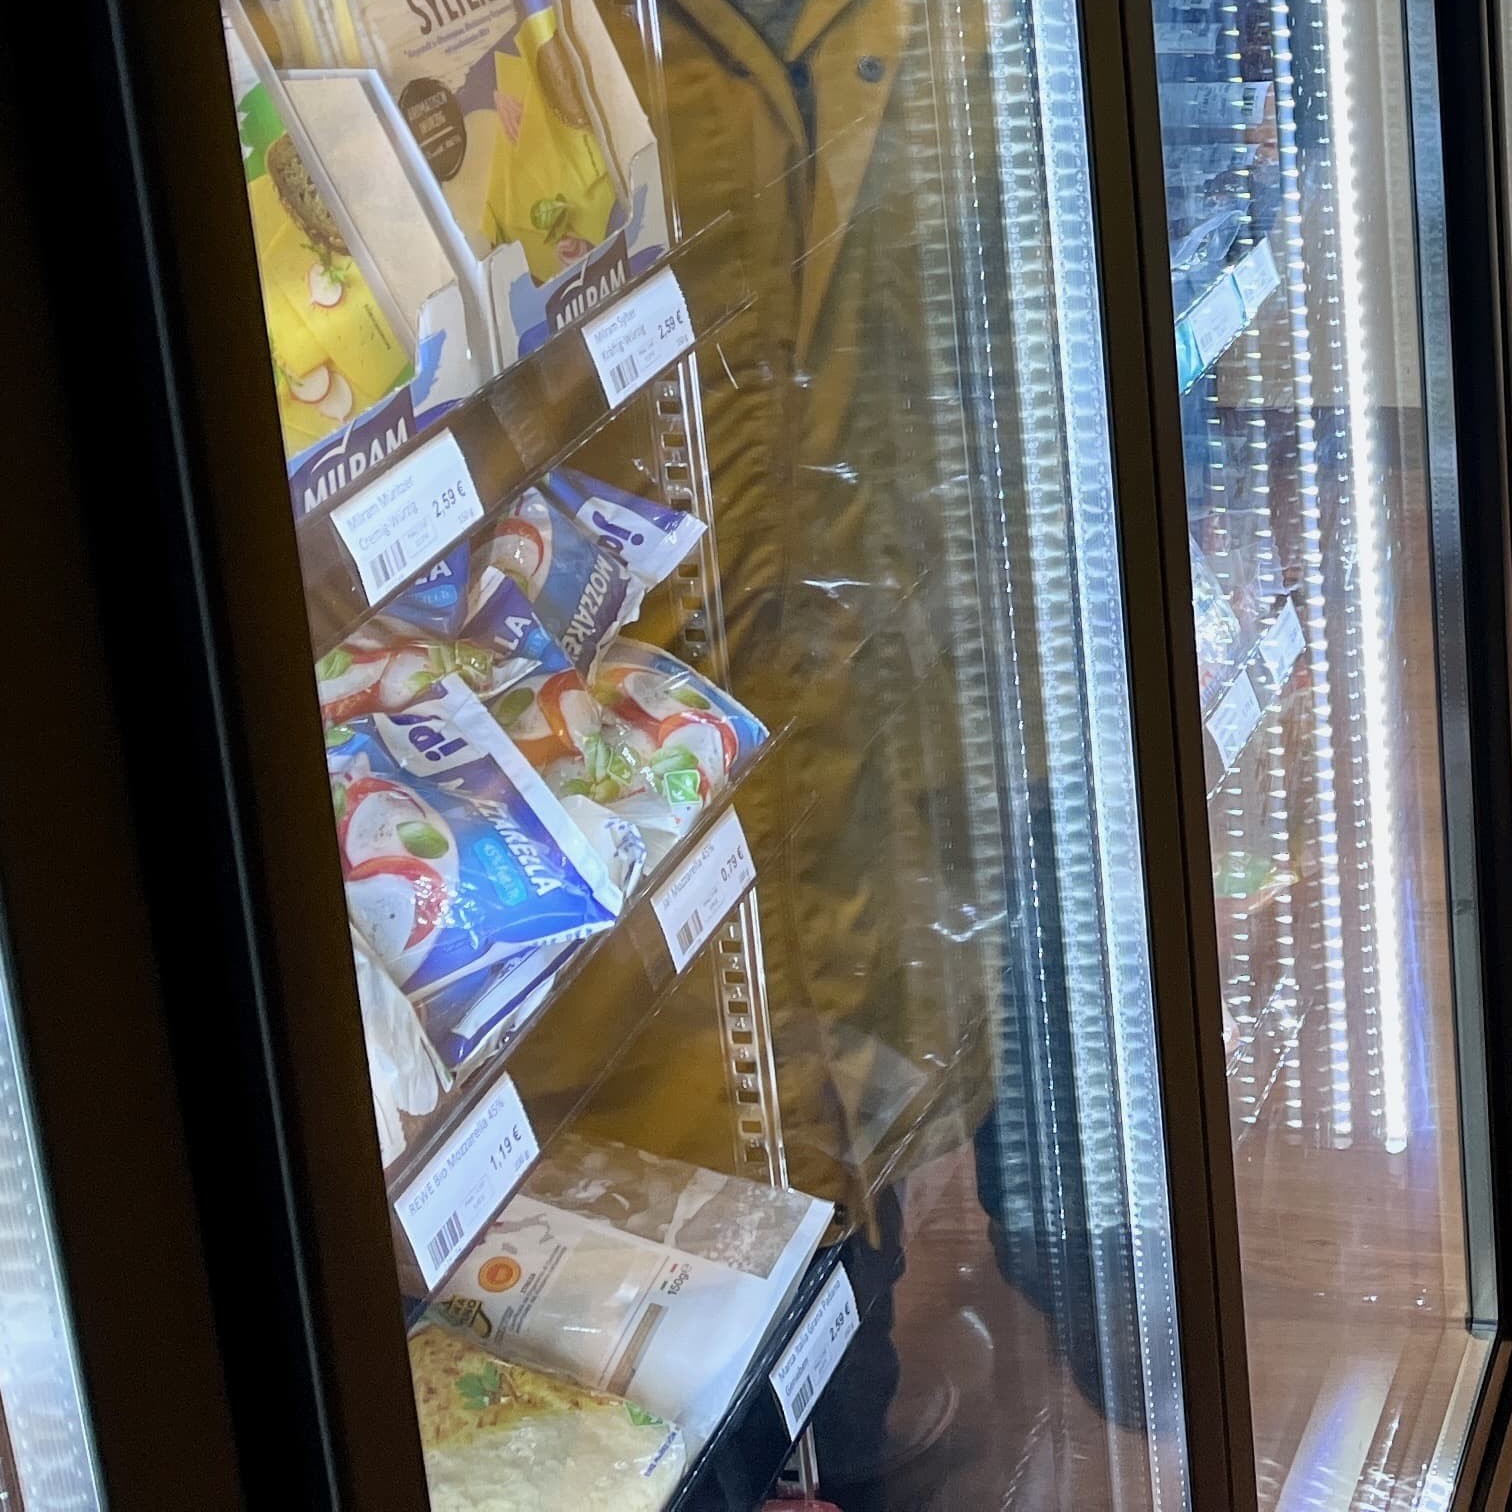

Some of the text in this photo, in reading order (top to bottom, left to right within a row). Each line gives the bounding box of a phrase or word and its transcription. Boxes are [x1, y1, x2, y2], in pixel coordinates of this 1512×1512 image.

[657, 309, 684, 340] 2,59 €
[431, 480, 466, 518] 2,59 €
[720, 856, 739, 882] 0,79
[737, 844, 745, 859] €
[408, 1183, 435, 1216] REWE
[434, 1167, 449, 1187] Bio
[446, 1118, 489, 1170] Mozzarella
[487, 1099, 505, 1121] 45%
[489, 1138, 514, 1173] 1,19
[512, 1123, 523, 1142] €
[829, 1311, 846, 1342] 2,59
